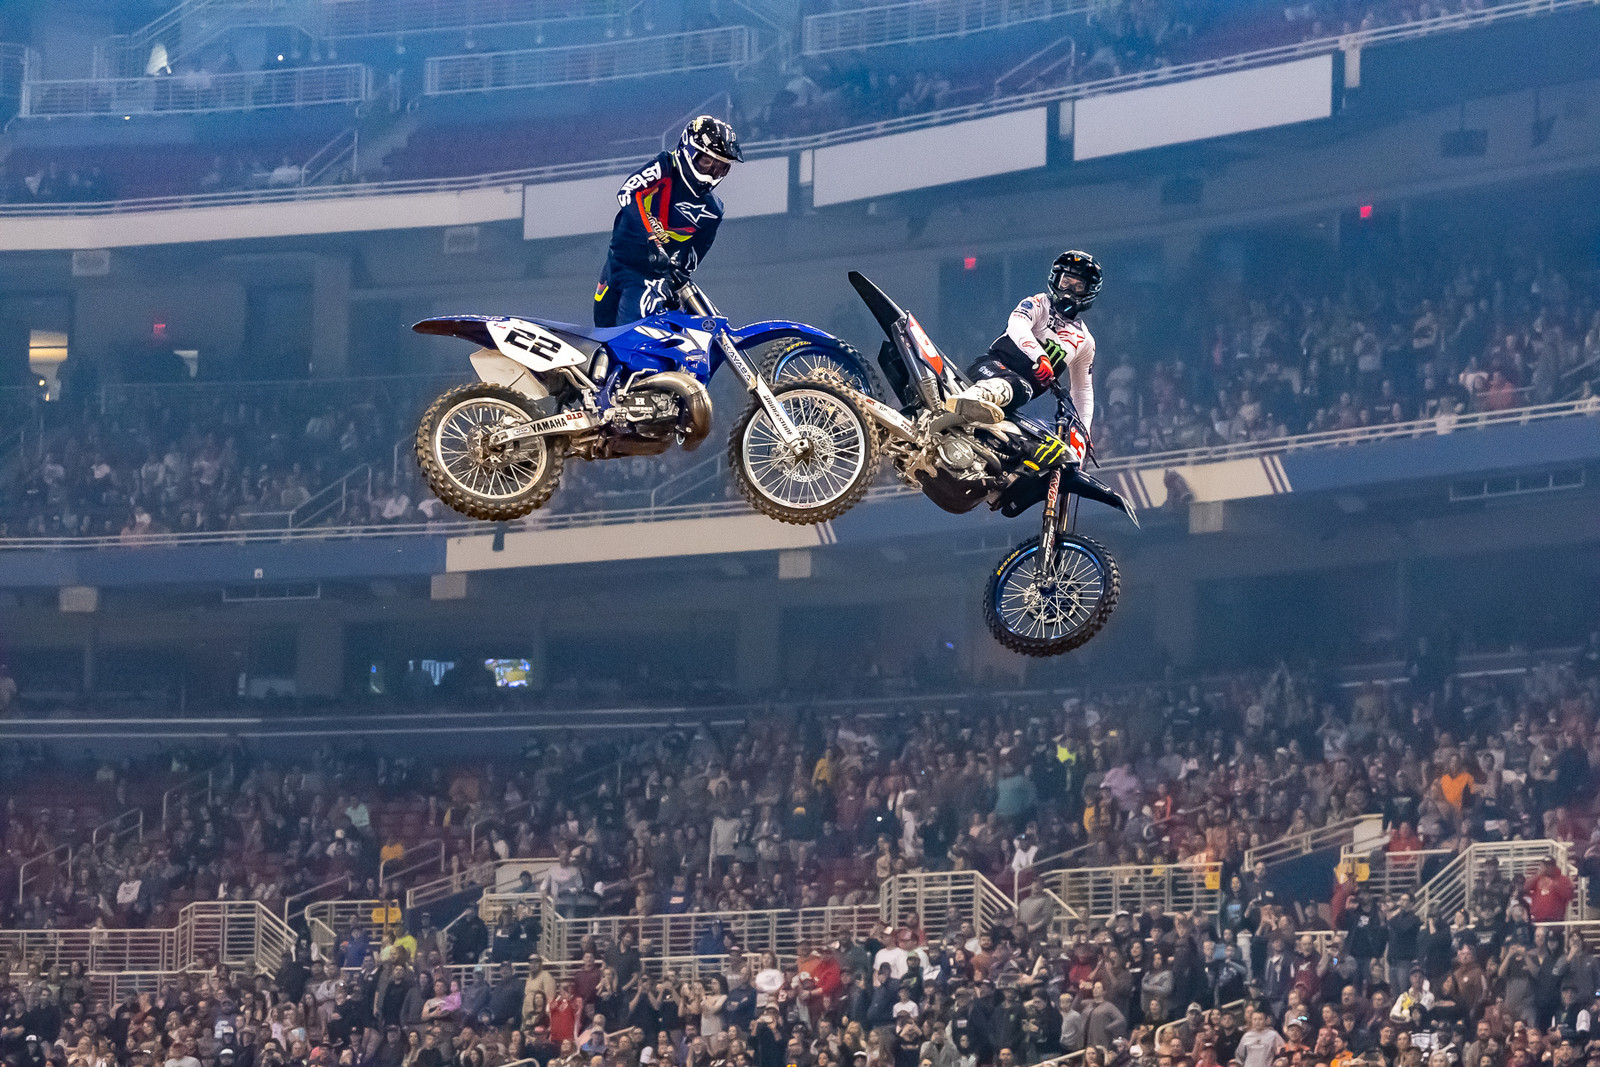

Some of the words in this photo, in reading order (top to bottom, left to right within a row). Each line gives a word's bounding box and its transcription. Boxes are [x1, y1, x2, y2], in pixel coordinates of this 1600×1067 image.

[503, 326, 562, 362] 22
[722, 342, 752, 382] KAYABA
[529, 417, 568, 434] YAMAHA
[996, 550, 1020, 577] DUNLOP
